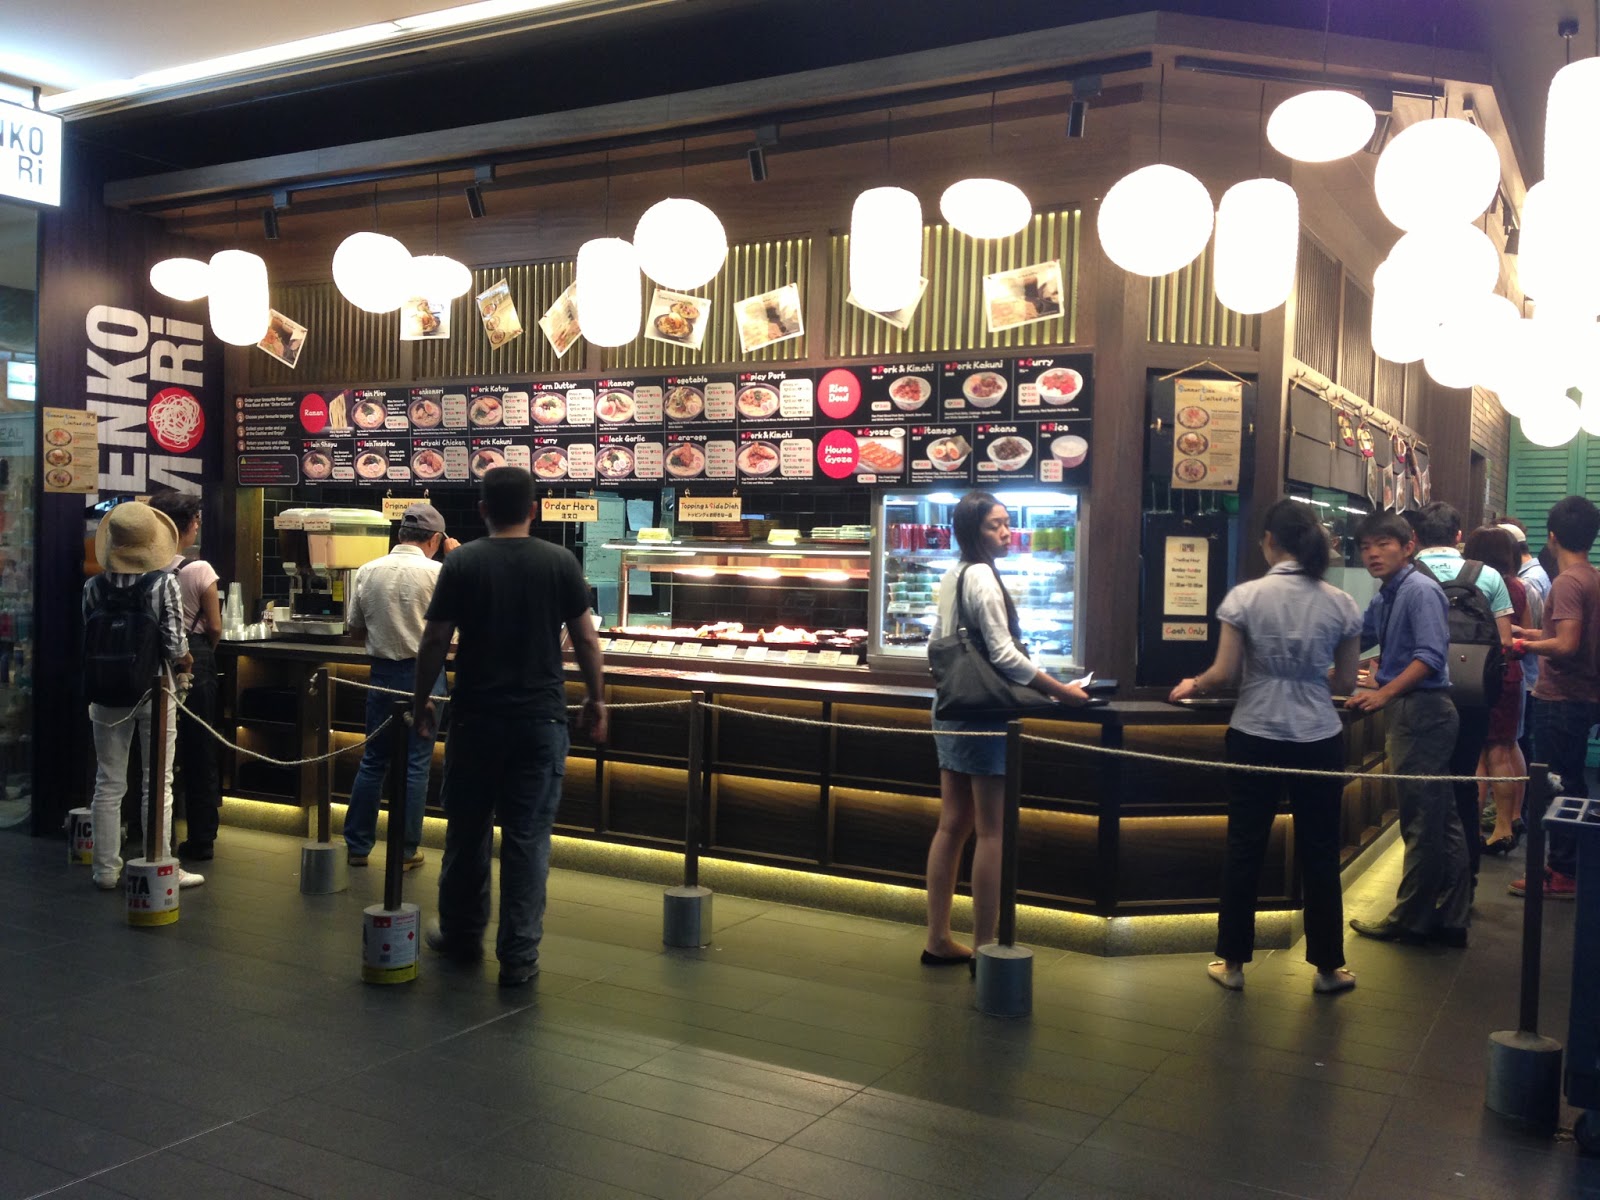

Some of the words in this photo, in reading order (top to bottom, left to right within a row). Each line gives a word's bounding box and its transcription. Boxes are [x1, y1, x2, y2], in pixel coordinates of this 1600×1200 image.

[973, 360, 1003, 369] Kakuni
[1026, 358, 1053, 367] Curry
[878, 365, 898, 374] Pork
[906, 363, 934, 372] Kimchi
[672, 376, 708, 384] Vegetable
[745, 373, 767, 382] Spicy
[538, 382, 553, 390] Corn
[828, 384, 849, 393] Rice
[828, 393, 849, 403] Bowl
[984, 425, 1017, 433] Takana
[1047, 423, 1068, 432] Rice
[769, 430, 793, 439] Kimchi
[863, 428, 889, 437] Gyoza
[539, 437, 557, 445] Curry
[825, 445, 852, 454] House
[825, 455, 853, 464] Gyoza
[385, 501, 410, 510] Original
[544, 501, 572, 510] Order
[573, 502, 595, 511] Here
[1166, 626, 1186, 635] Cash
[1188, 626, 1206, 636] Only
[77, 822, 93, 838] IC
[77, 841, 94, 849] FU
